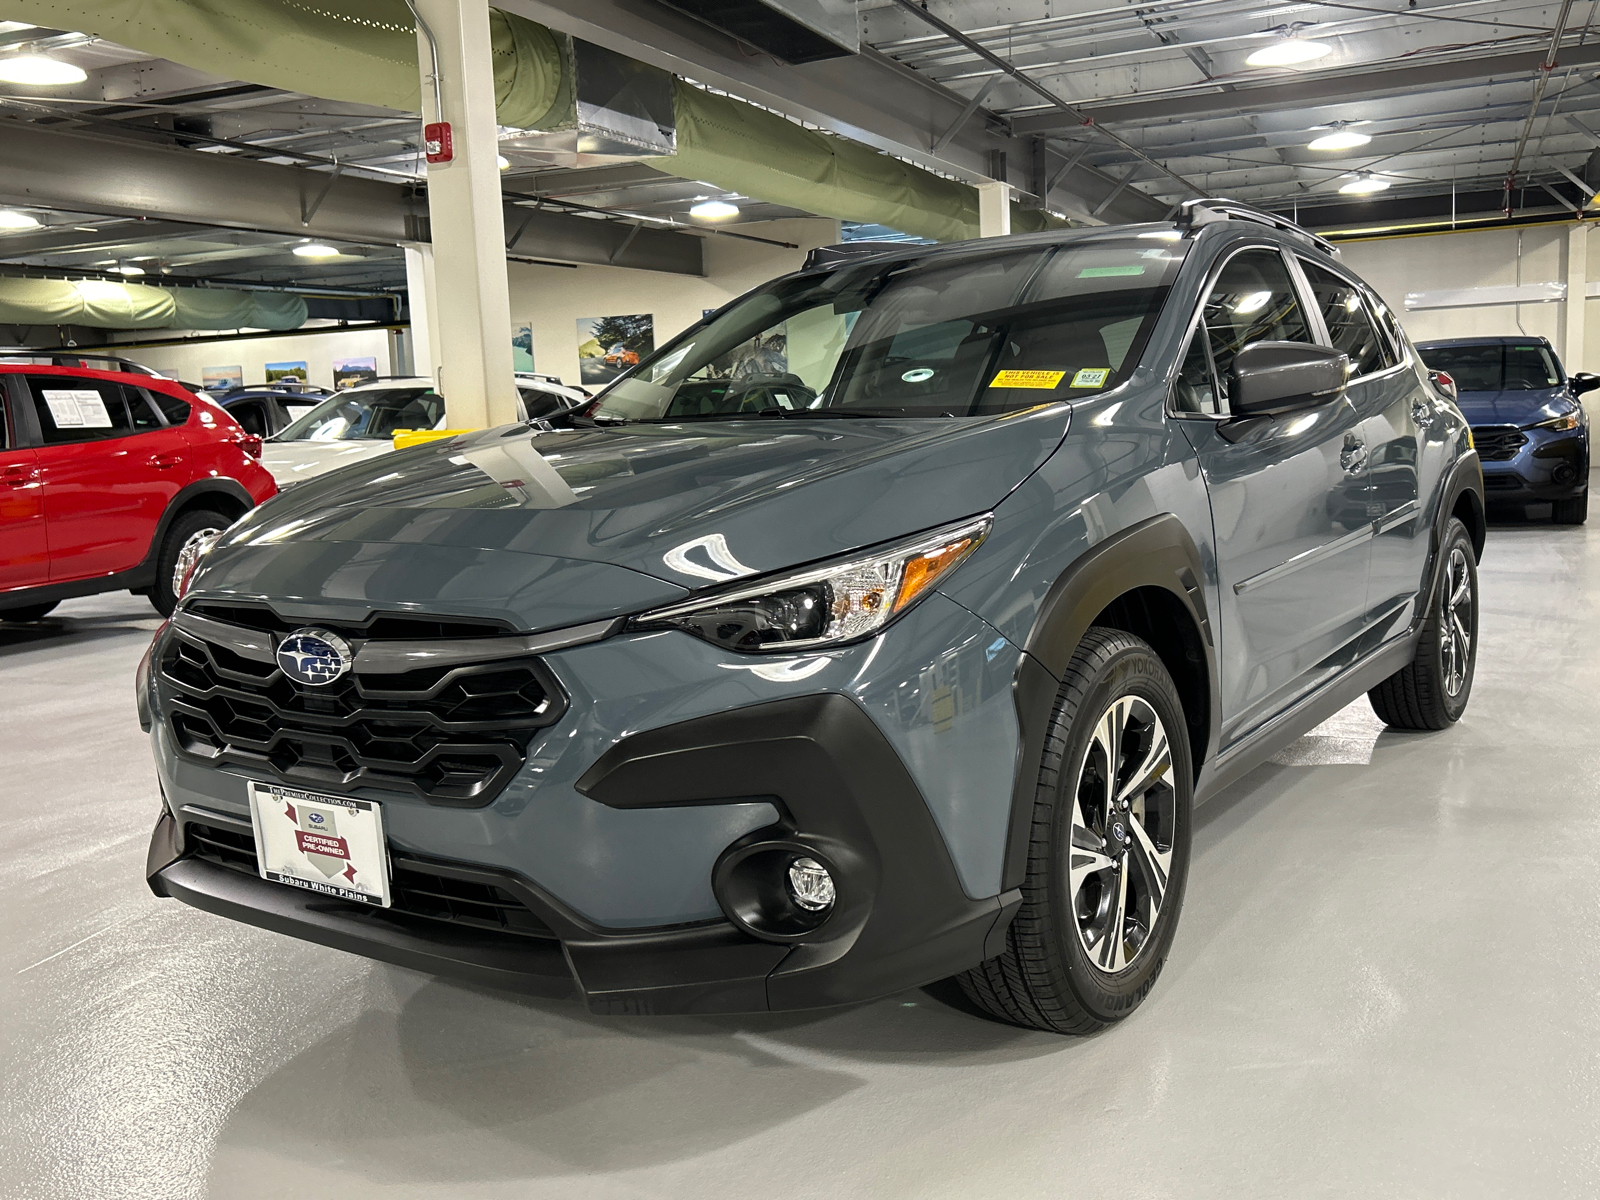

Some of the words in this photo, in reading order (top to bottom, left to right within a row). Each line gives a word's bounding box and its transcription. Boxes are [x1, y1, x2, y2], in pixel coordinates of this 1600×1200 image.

[308, 823, 328, 832] SUBARU
[301, 841, 345, 856] PRE-OWNED
[303, 834, 339, 848] CERTIFIED
[279, 874, 308, 889] Subaru
[311, 882, 337, 895] White
[339, 889, 368, 902] Plains
[1092, 957, 1163, 1011] GEOLAND
